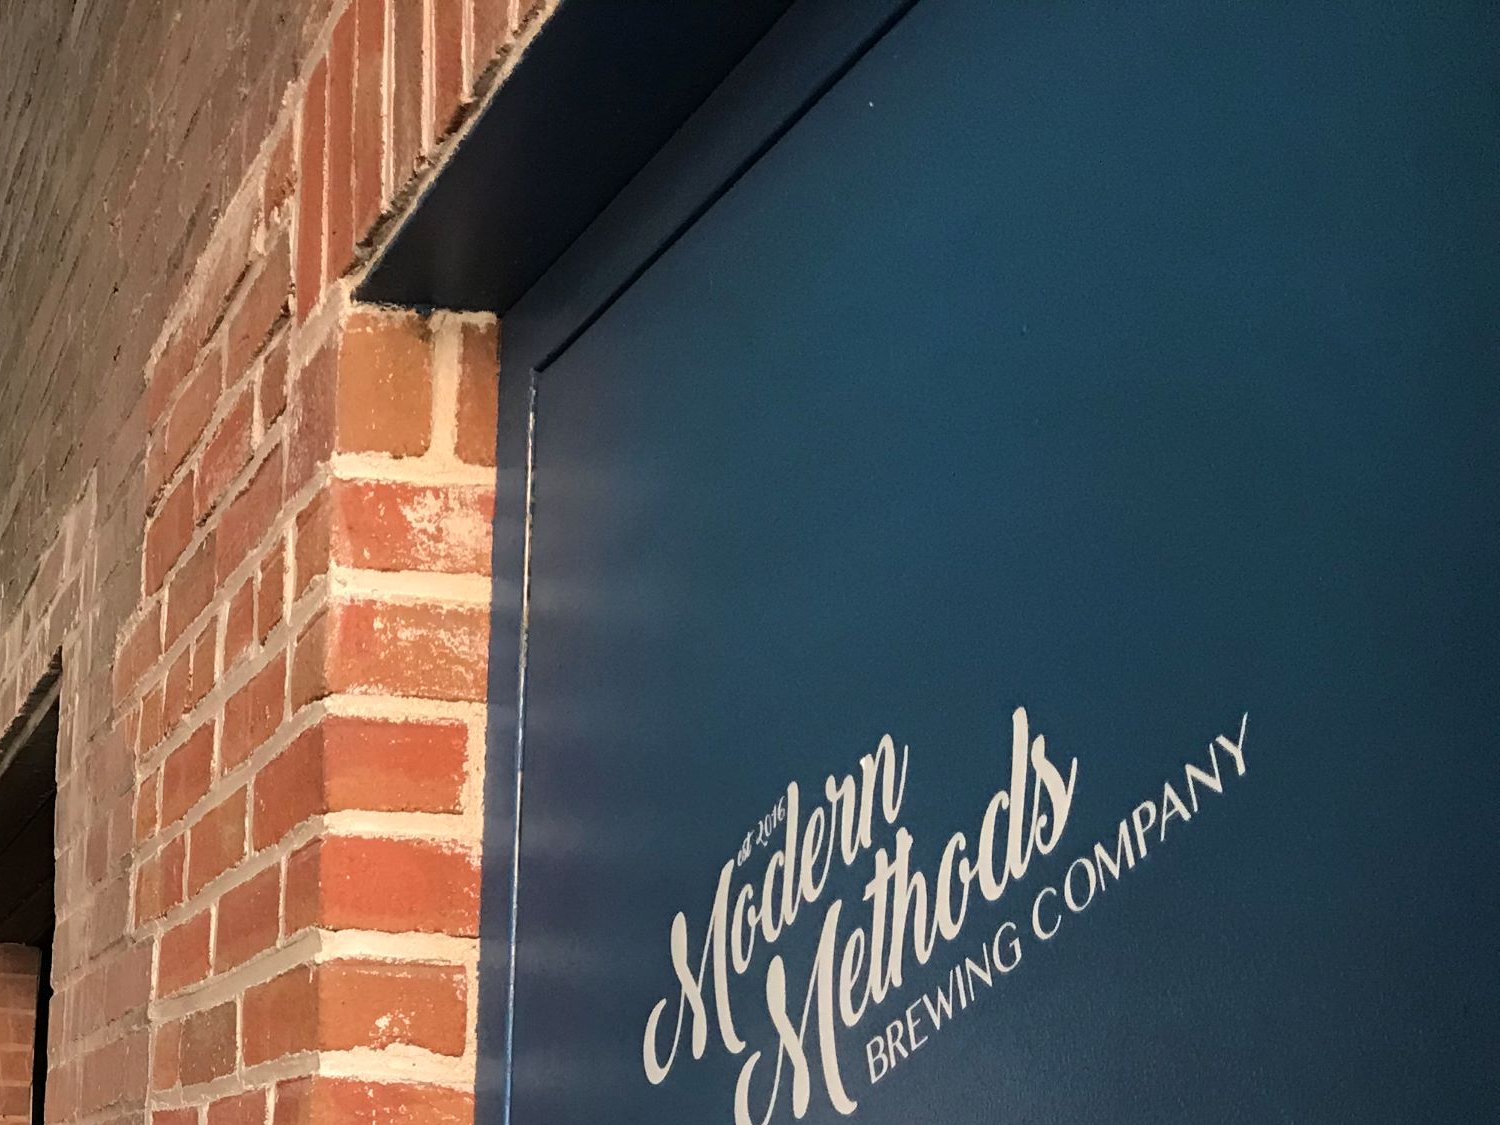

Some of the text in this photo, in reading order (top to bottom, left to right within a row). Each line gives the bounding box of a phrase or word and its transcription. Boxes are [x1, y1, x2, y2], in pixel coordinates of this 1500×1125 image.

[643, 734, 909, 1085] Modern
[755, 796, 786, 847] 2016
[865, 711, 1249, 1085] BREWING COMPANY
